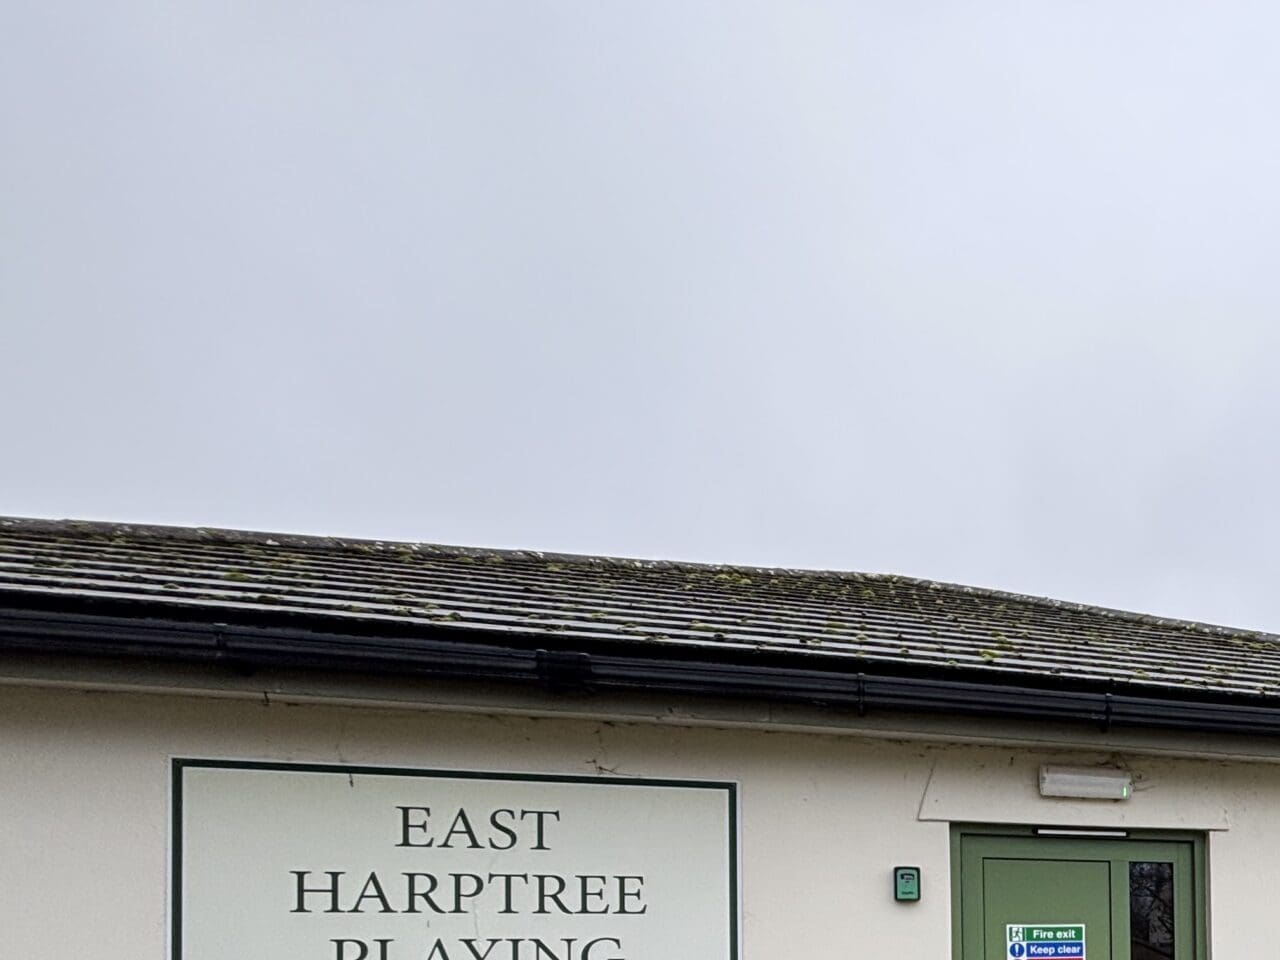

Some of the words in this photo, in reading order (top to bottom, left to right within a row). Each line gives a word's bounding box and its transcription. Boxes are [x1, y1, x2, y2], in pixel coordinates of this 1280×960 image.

[395, 805, 560, 851] EAST
[289, 870, 648, 916] HARPTREE
[1033, 929, 1053, 939] Fire
[1056, 929, 1076, 939] exit
[1030, 945, 1055, 955] Keep
[1058, 945, 1080, 954] clear
